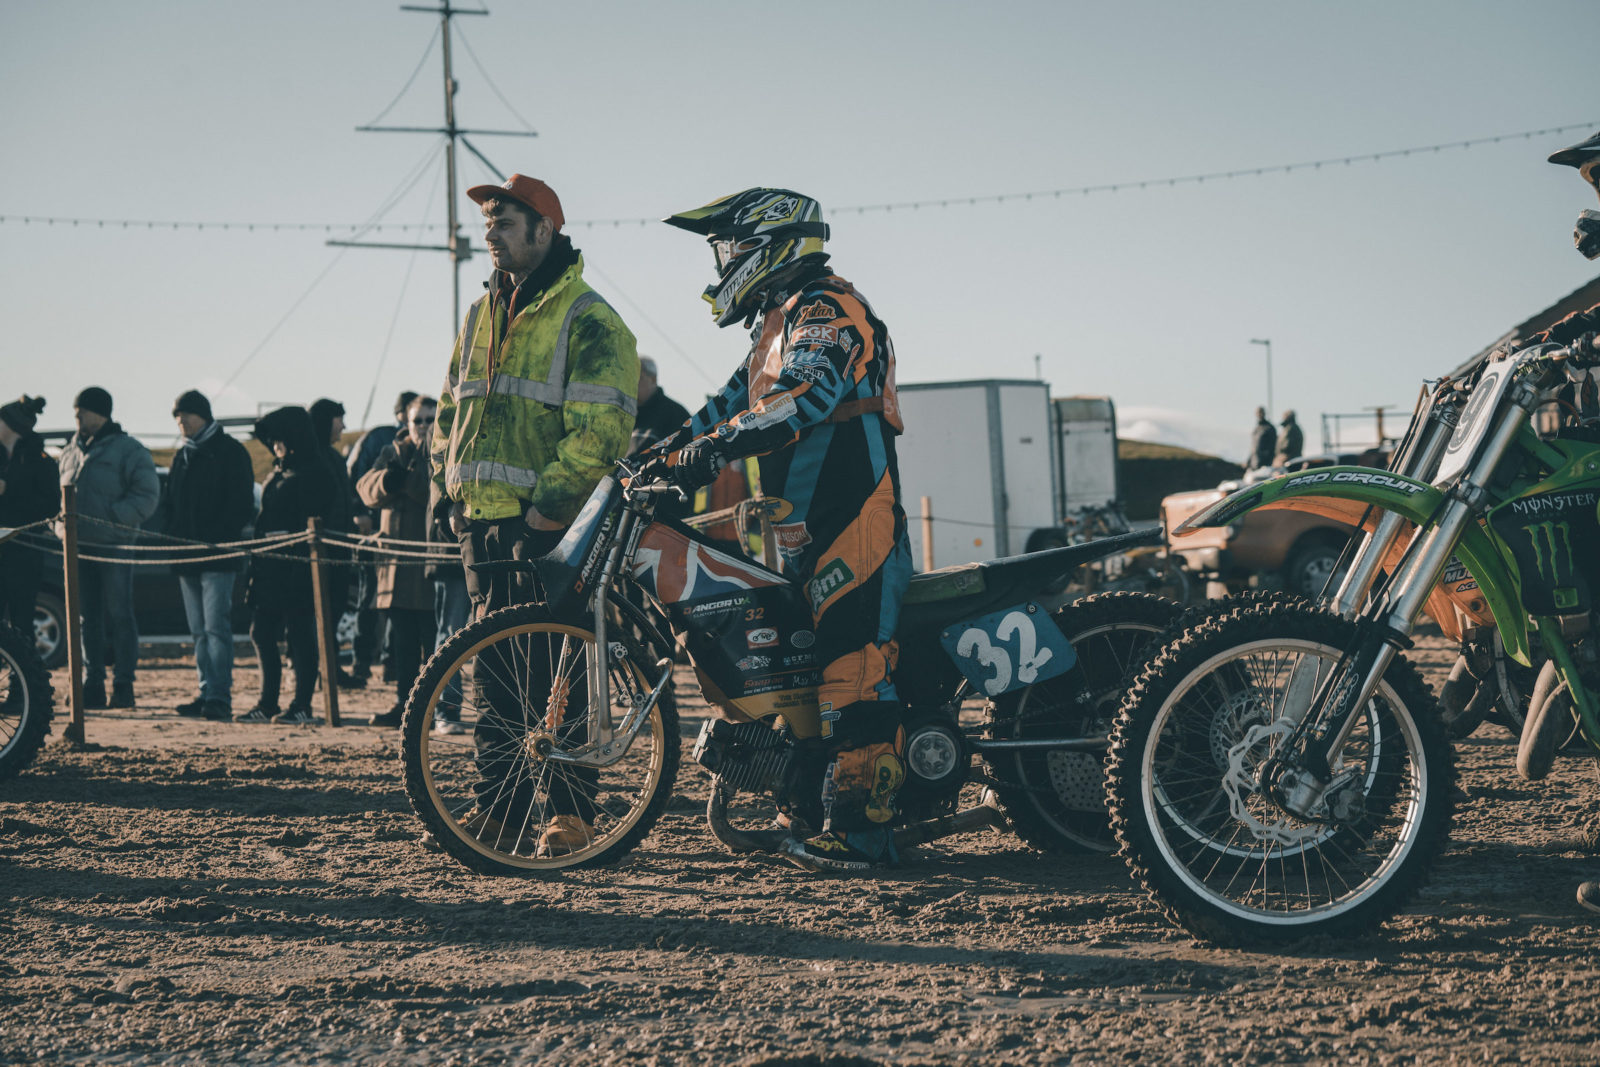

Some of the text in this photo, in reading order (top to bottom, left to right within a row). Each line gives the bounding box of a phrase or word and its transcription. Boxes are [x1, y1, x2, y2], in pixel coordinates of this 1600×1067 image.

[1281, 472, 1428, 494] PRO CIRCUIT
[1512, 493, 1597, 514] MONSTER
[744, 607, 765, 622] 32
[956, 611, 1053, 697] 32
